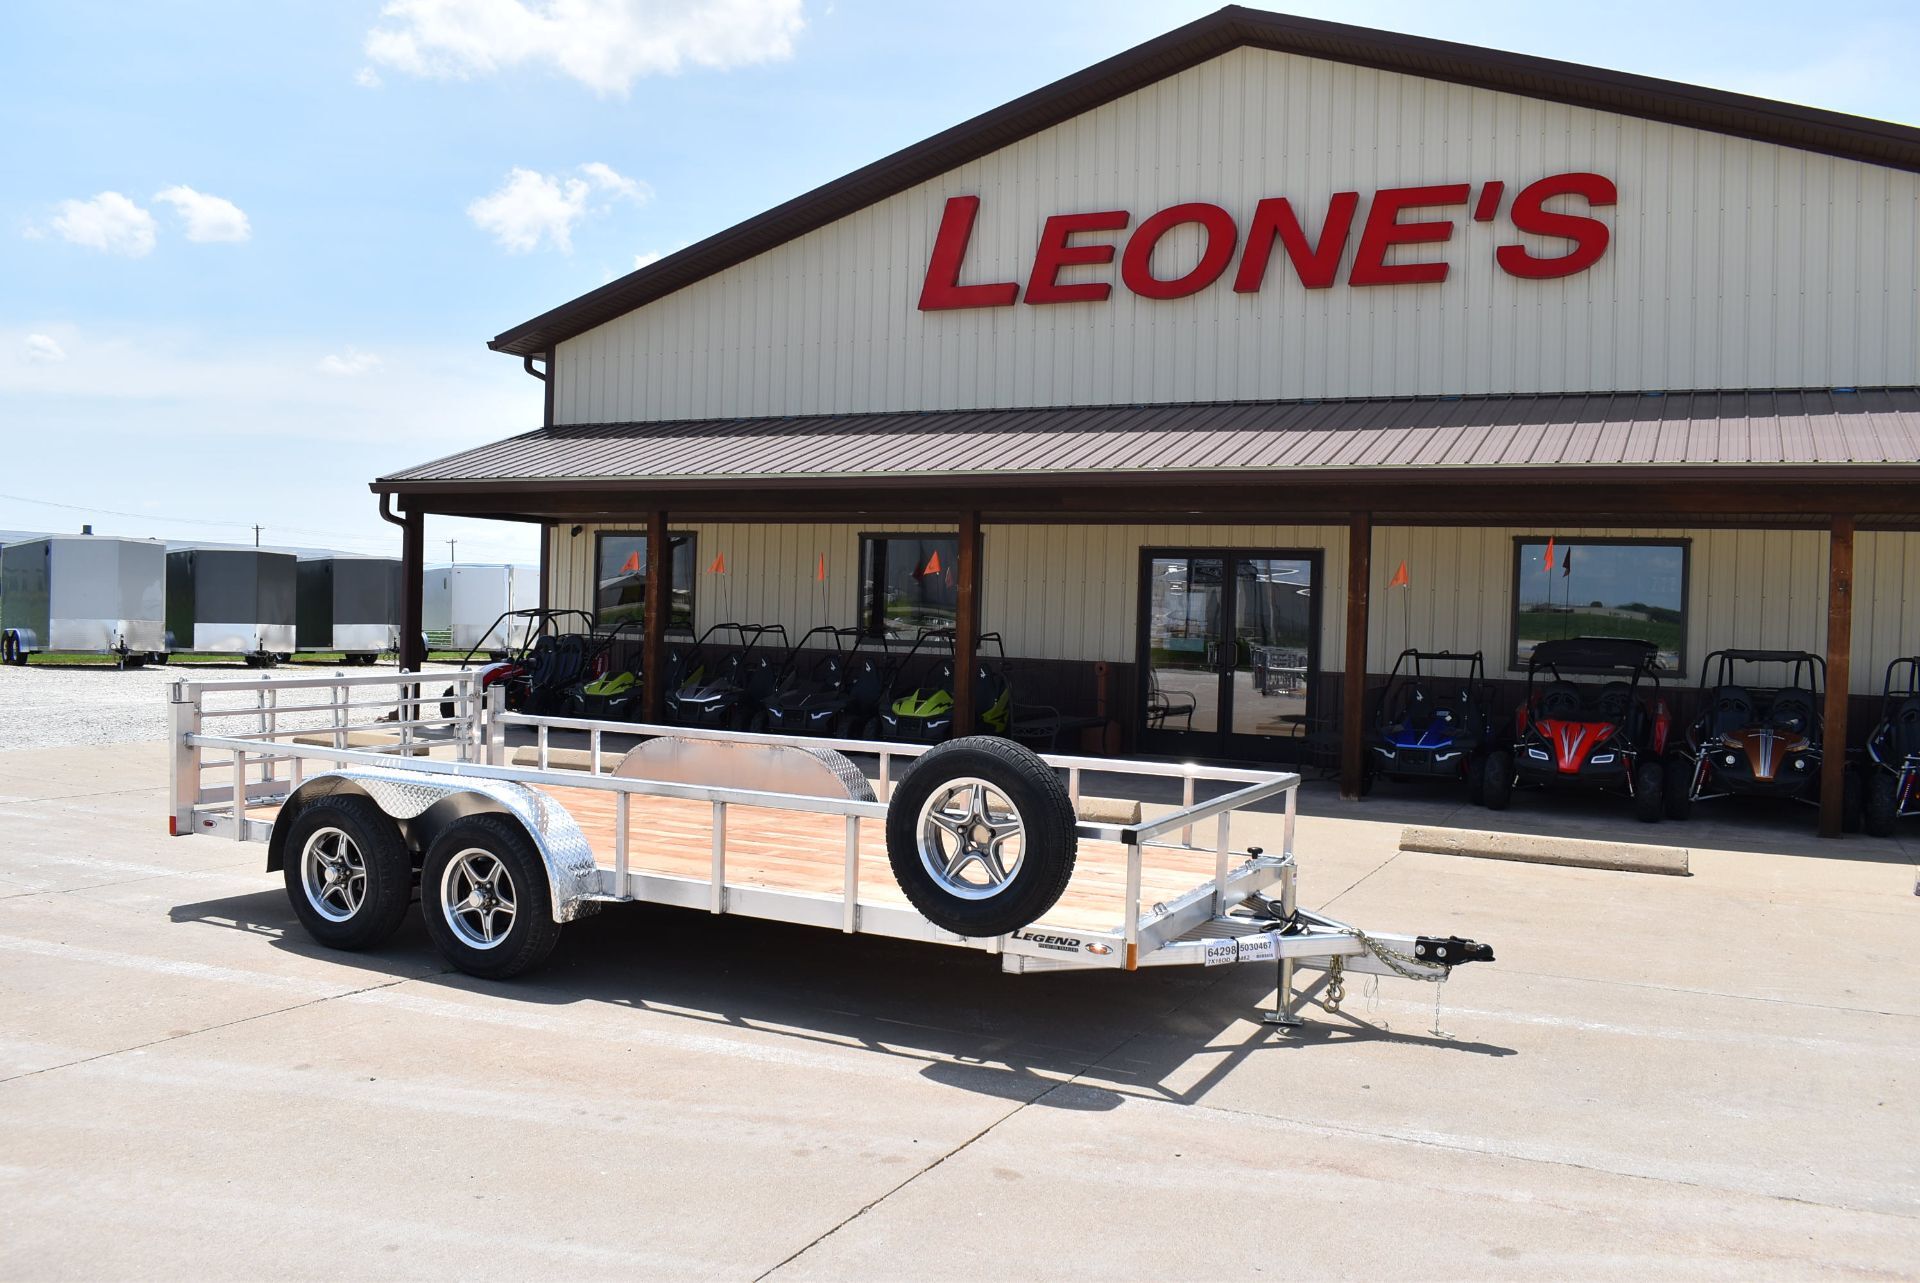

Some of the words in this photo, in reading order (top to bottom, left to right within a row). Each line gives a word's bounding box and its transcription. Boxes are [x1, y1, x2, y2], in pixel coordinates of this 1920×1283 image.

[918, 173, 1617, 311] LEONE'S
[1011, 930, 1080, 947] LEGEND
[1207, 945, 1236, 958] 64298
[1240, 941, 1272, 952] 5030467
